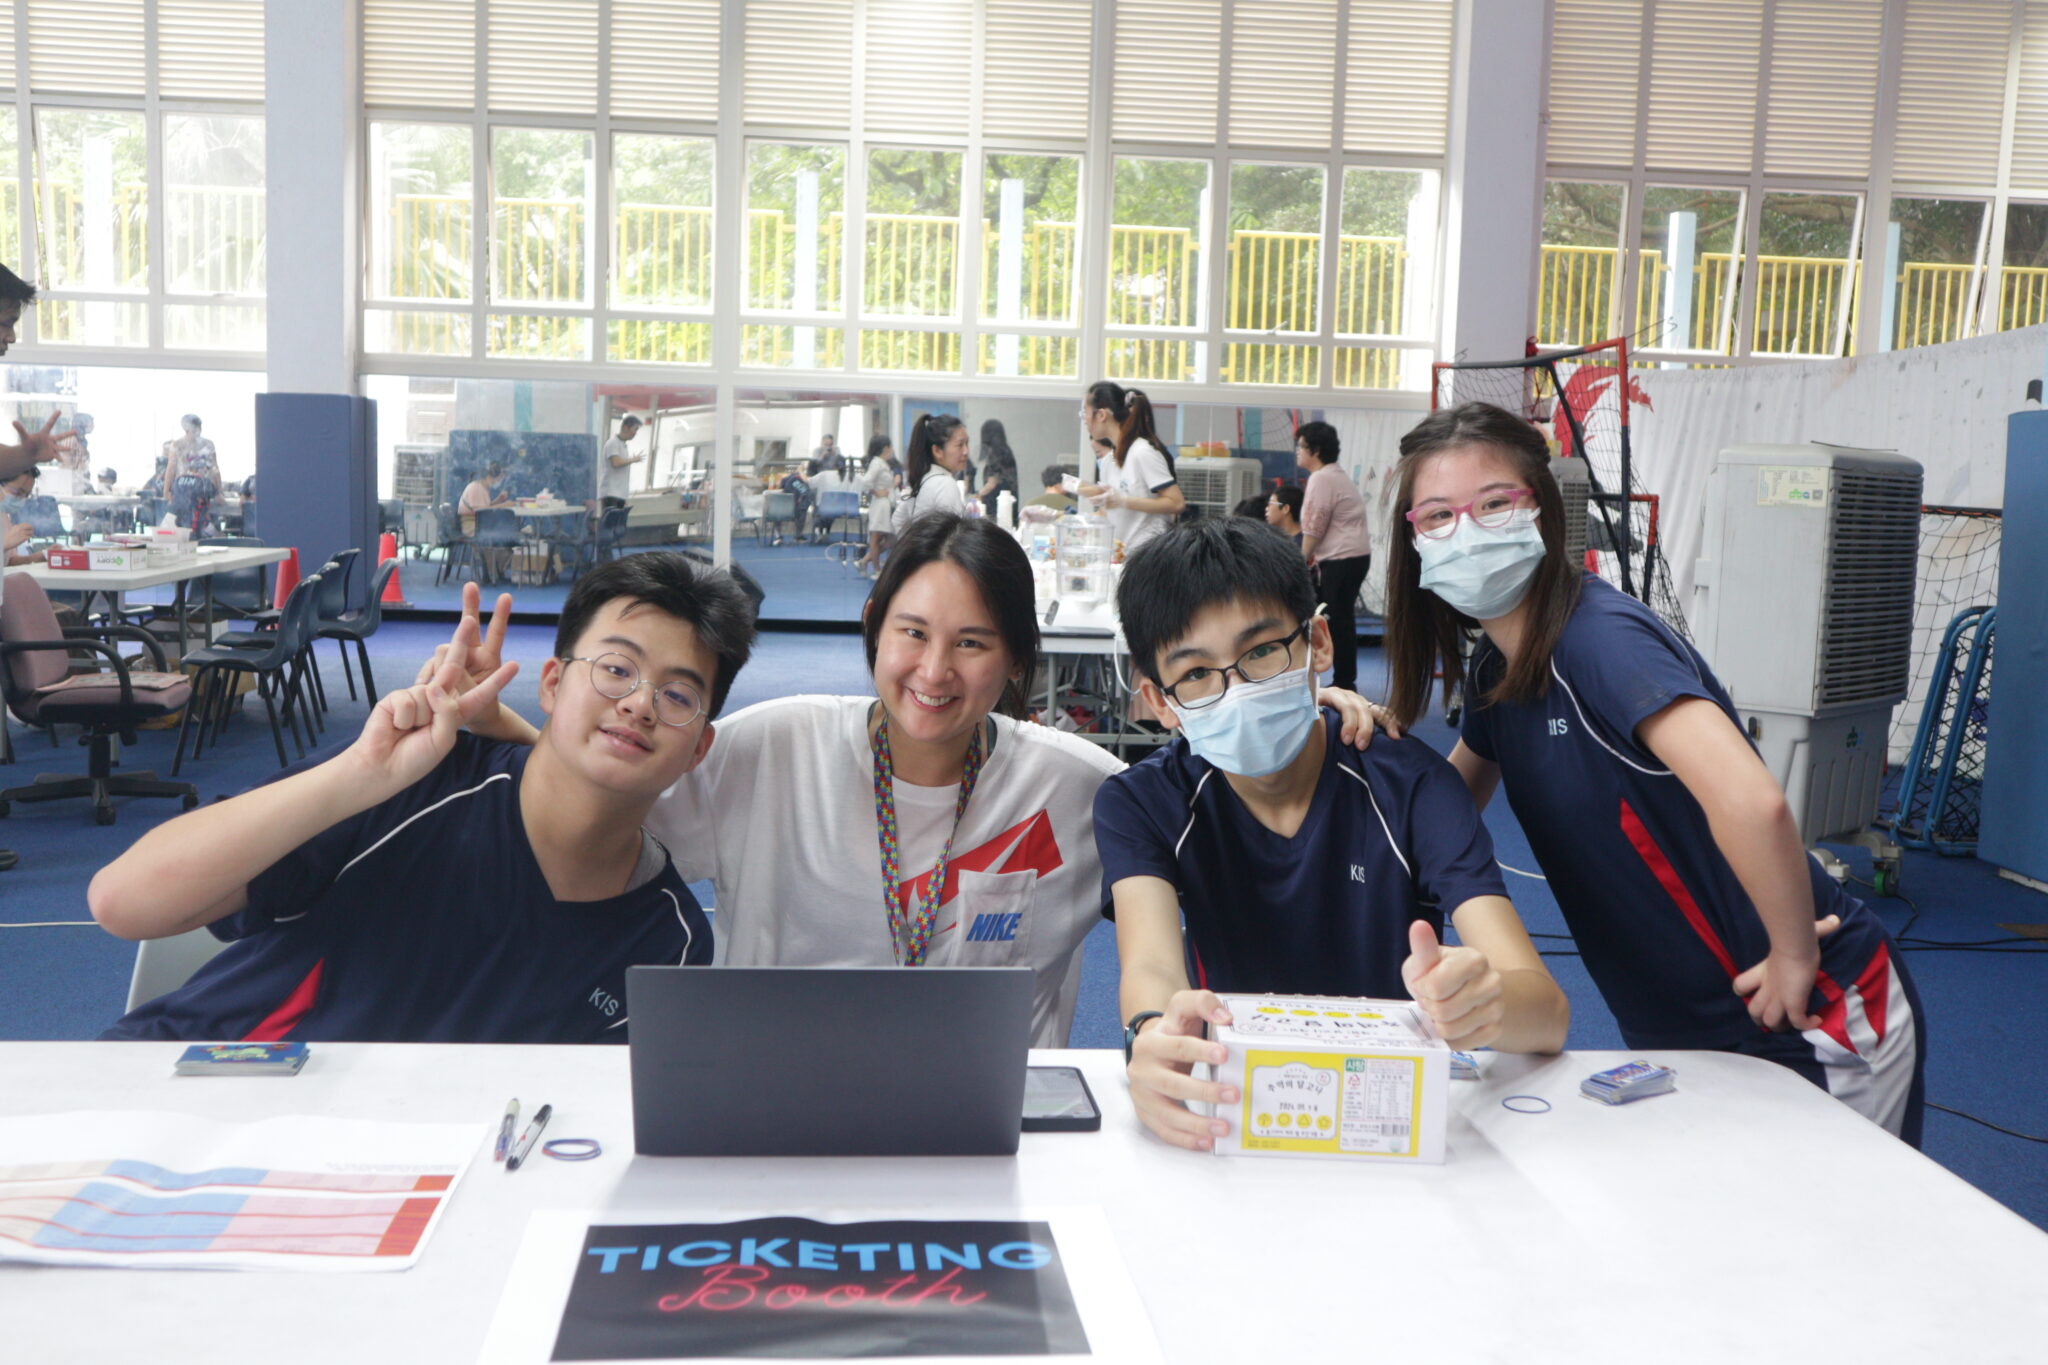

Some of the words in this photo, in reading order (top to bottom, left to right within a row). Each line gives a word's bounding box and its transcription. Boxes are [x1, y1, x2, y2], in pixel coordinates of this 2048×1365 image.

[1350, 863, 1365, 883] KIS
[966, 913, 1022, 941] NIKE
[588, 987, 619, 1016] KIS
[588, 1238, 1051, 1273] TICKETING
[659, 1263, 987, 1312] Booth
